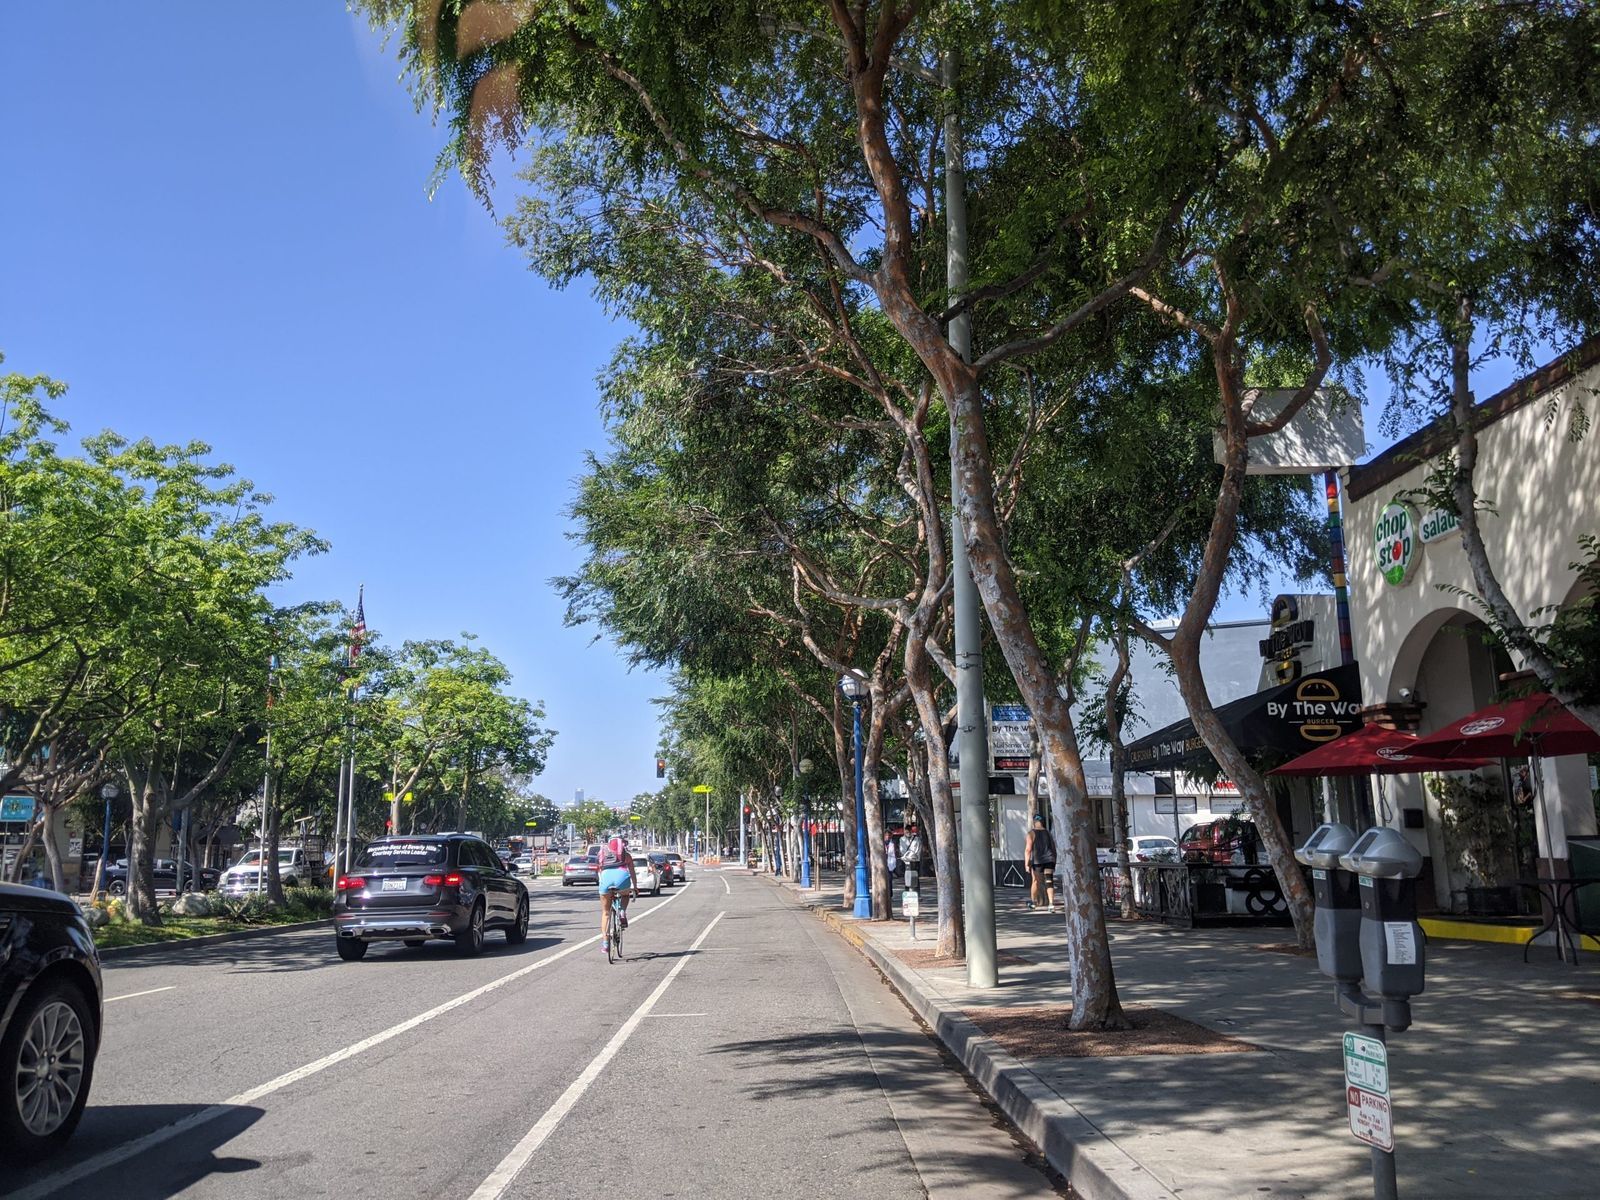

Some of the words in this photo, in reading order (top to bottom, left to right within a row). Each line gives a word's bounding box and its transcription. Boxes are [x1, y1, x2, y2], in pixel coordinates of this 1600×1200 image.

[1376, 511, 1407, 542] chop
[1380, 536, 1410, 567] stop
[1267, 702, 1288, 719] By
[1292, 701, 1326, 716] The
[1330, 701, 1363, 715] Wa
[992, 725, 1002, 733] By
[1152, 745, 1160, 761] By
[1171, 740, 1185, 756] Way
[1349, 1091, 1360, 1105] NO
[1361, 1094, 1388, 1113] PARKING
